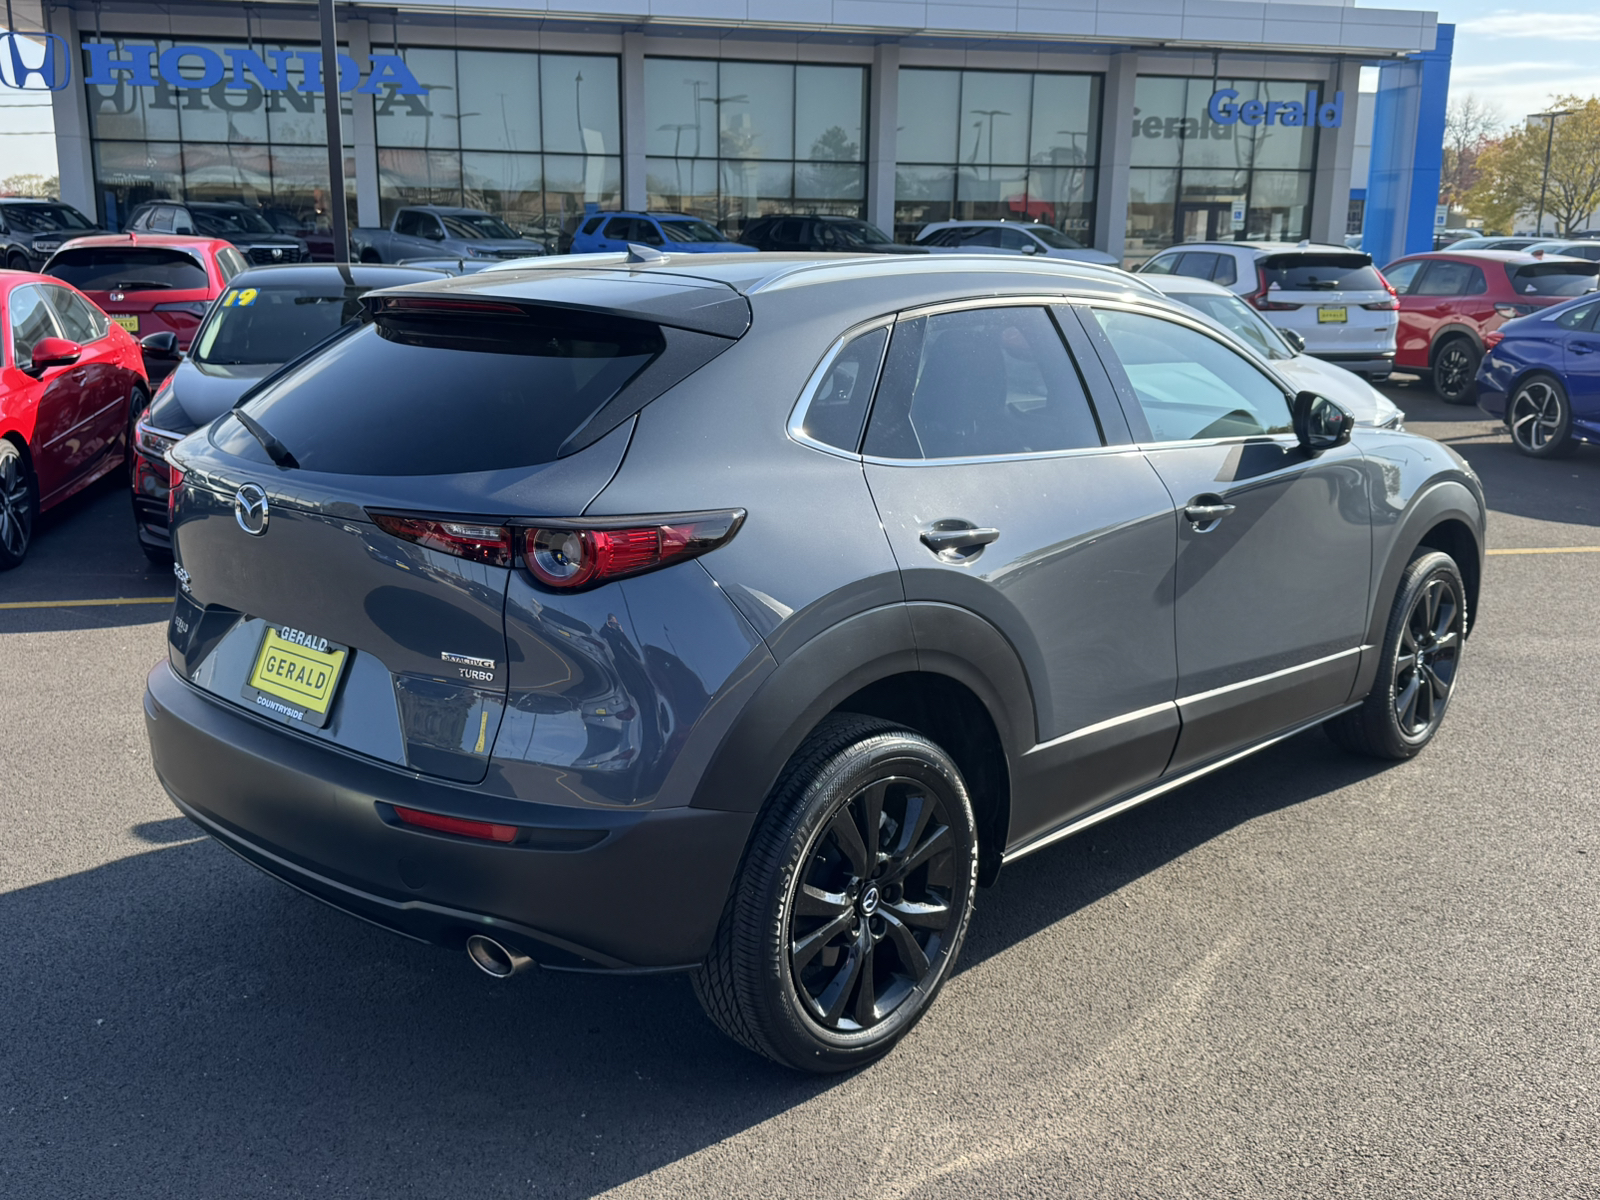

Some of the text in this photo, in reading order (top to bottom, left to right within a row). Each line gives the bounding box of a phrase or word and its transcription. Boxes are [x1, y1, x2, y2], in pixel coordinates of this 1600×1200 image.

[82, 42, 429, 95] HONDA
[1208, 88, 1345, 128] Gerald
[223, 288, 257, 306] 19
[281, 626, 328, 652] GERALD
[266, 655, 326, 690] GERALD
[458, 667, 494, 682] TURBO
[256, 696, 304, 720] COUNTRYSIDE
